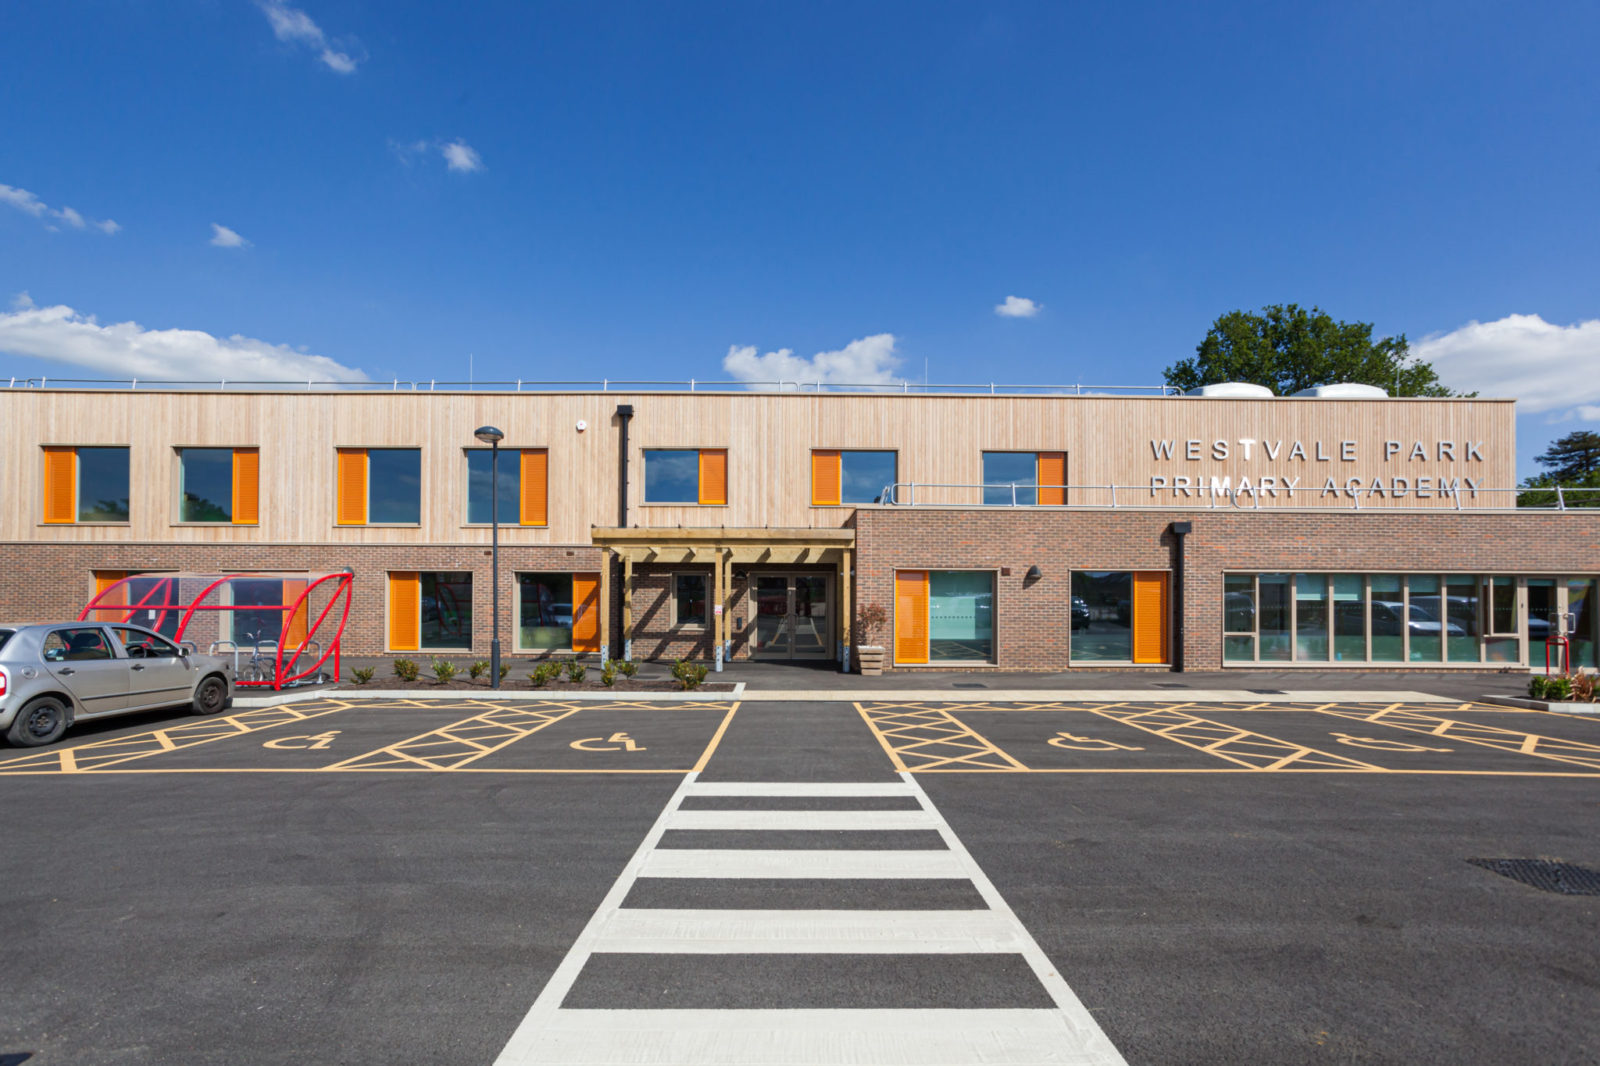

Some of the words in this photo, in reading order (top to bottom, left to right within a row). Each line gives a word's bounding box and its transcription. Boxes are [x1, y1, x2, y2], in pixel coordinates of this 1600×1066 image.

[1150, 438, 1357, 461] WESTVALE
[1385, 440, 1484, 461] PARK
[1150, 475, 1301, 497] PRIMARY
[1321, 476, 1484, 498] ACADEMY
